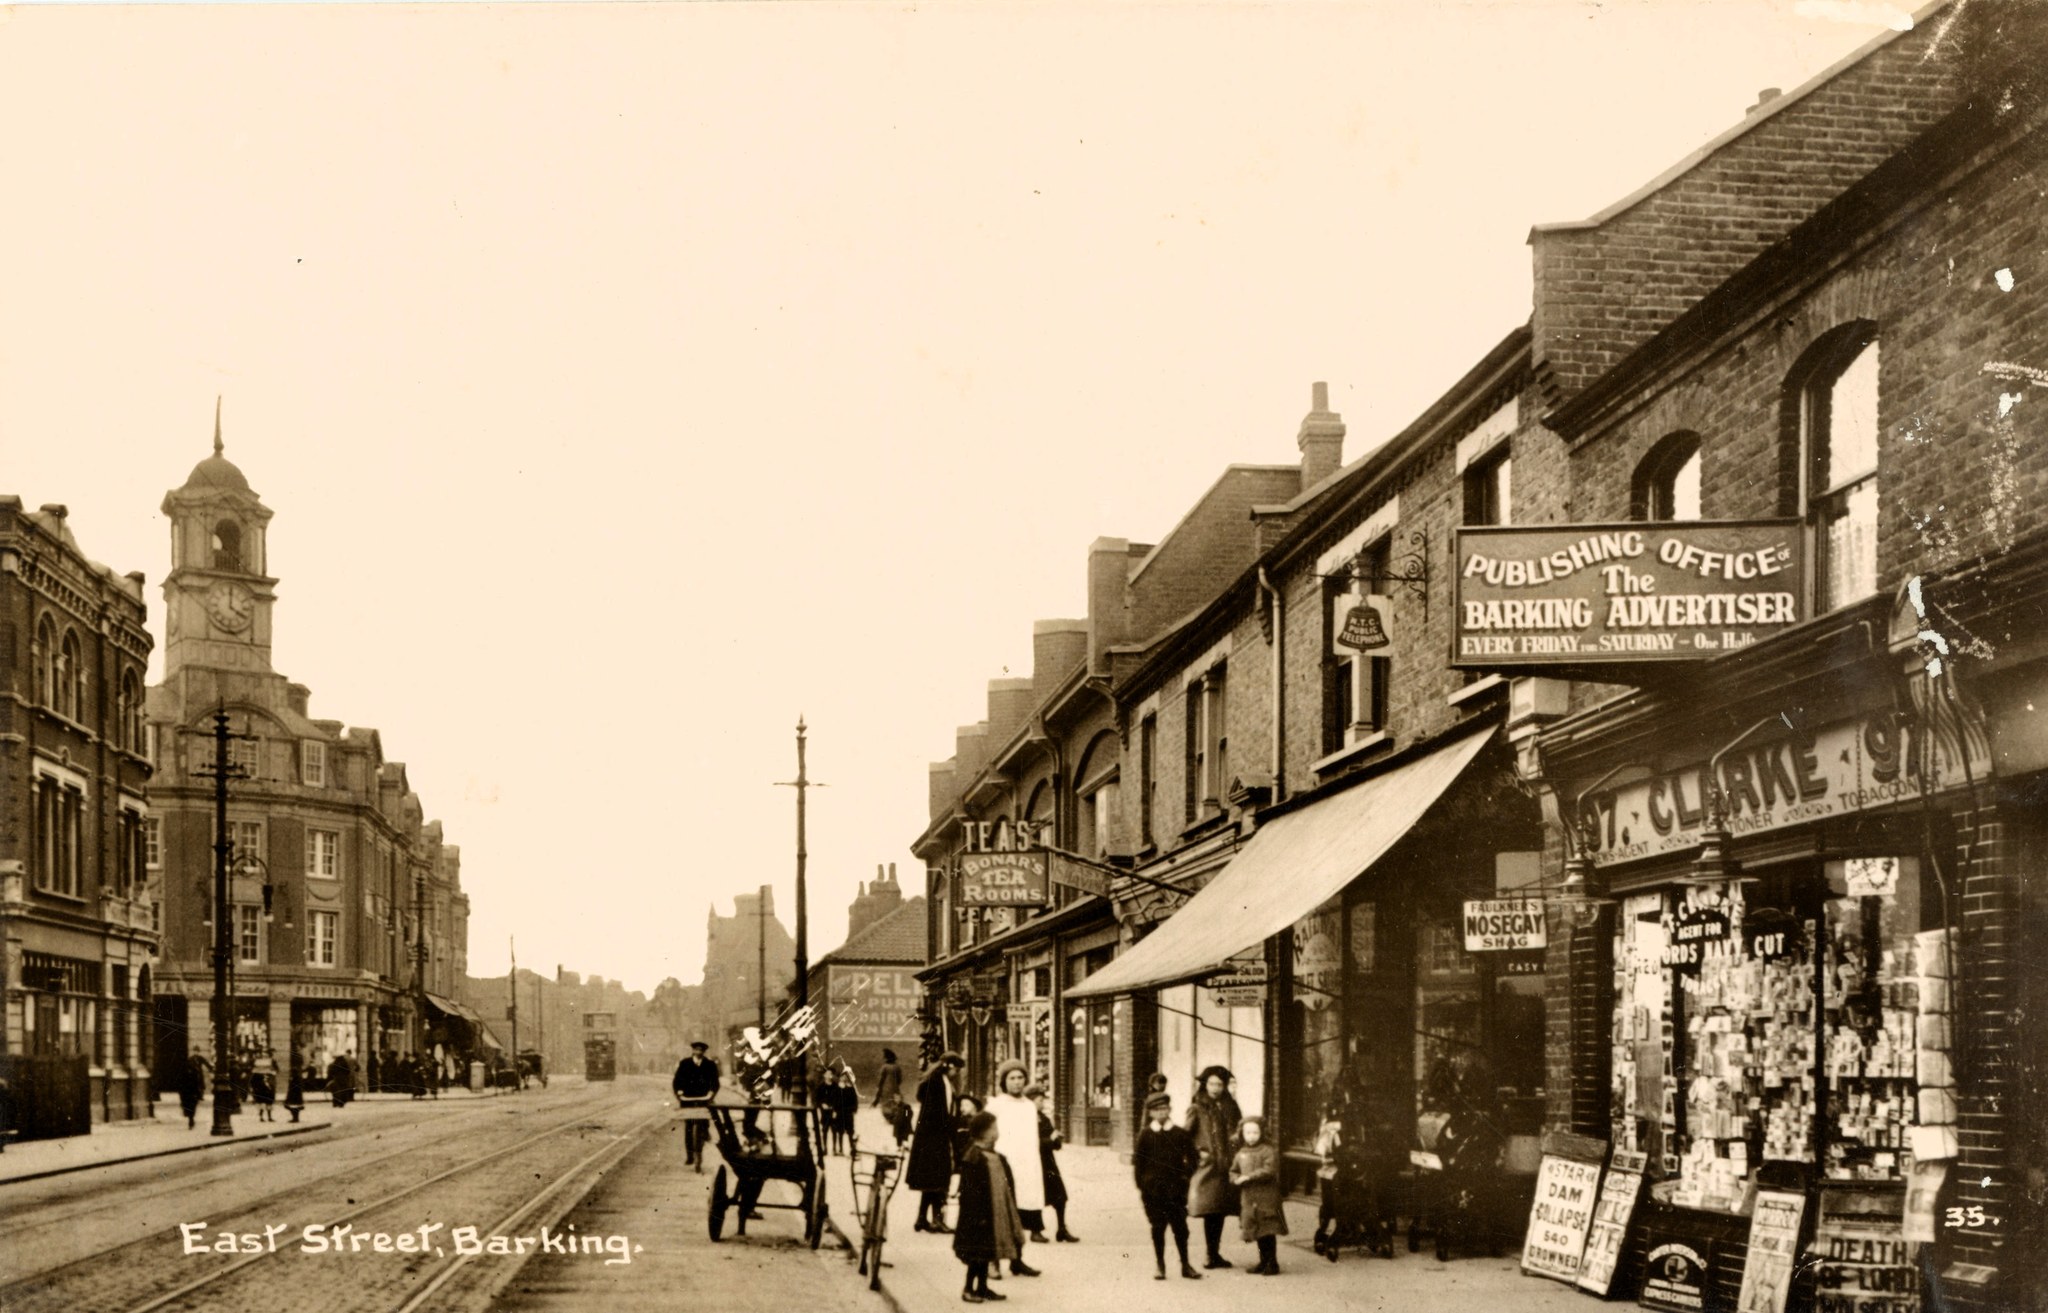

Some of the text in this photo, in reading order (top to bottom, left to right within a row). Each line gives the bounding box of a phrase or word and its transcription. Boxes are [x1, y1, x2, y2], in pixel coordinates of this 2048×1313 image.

[1463, 532, 1644, 587] PUBLISHING
[1659, 538, 1782, 580] OFFICE
[1601, 564, 1656, 594] The
[1463, 592, 1797, 630] BARKING ADVERTISER
[1342, 631, 1386, 645] TELEPHONE
[1348, 625, 1378, 635] PUBLIC
[1460, 636, 1518, 655] EVERY
[1521, 635, 1581, 654] FRIDAY
[1600, 632, 1678, 651] SATURDAY
[1694, 633, 1719, 650] One
[963, 821, 1029, 852] TEAS
[964, 854, 1045, 877] BONAR'S
[981, 868, 1026, 886] TEA
[963, 885, 1046, 901] ROOMS.
[954, 906, 1009, 922] TEAS
[1466, 914, 1545, 936] NOSEGAY
[1678, 921, 1722, 940] AGENT FOR
[1482, 936, 1529, 948] SHAG
[1754, 933, 1785, 957] CUT
[1555, 1164, 1585, 1182] STAR
[1548, 1183, 1583, 1204] DAM
[1536, 1203, 1587, 1232] COLLAPSE
[1544, 1230, 1569, 1246] 540
[1528, 1245, 1579, 1269] DROWNED
[1830, 1238, 1908, 1265] DEATH
[1859, 1267, 1917, 1293] LORD
